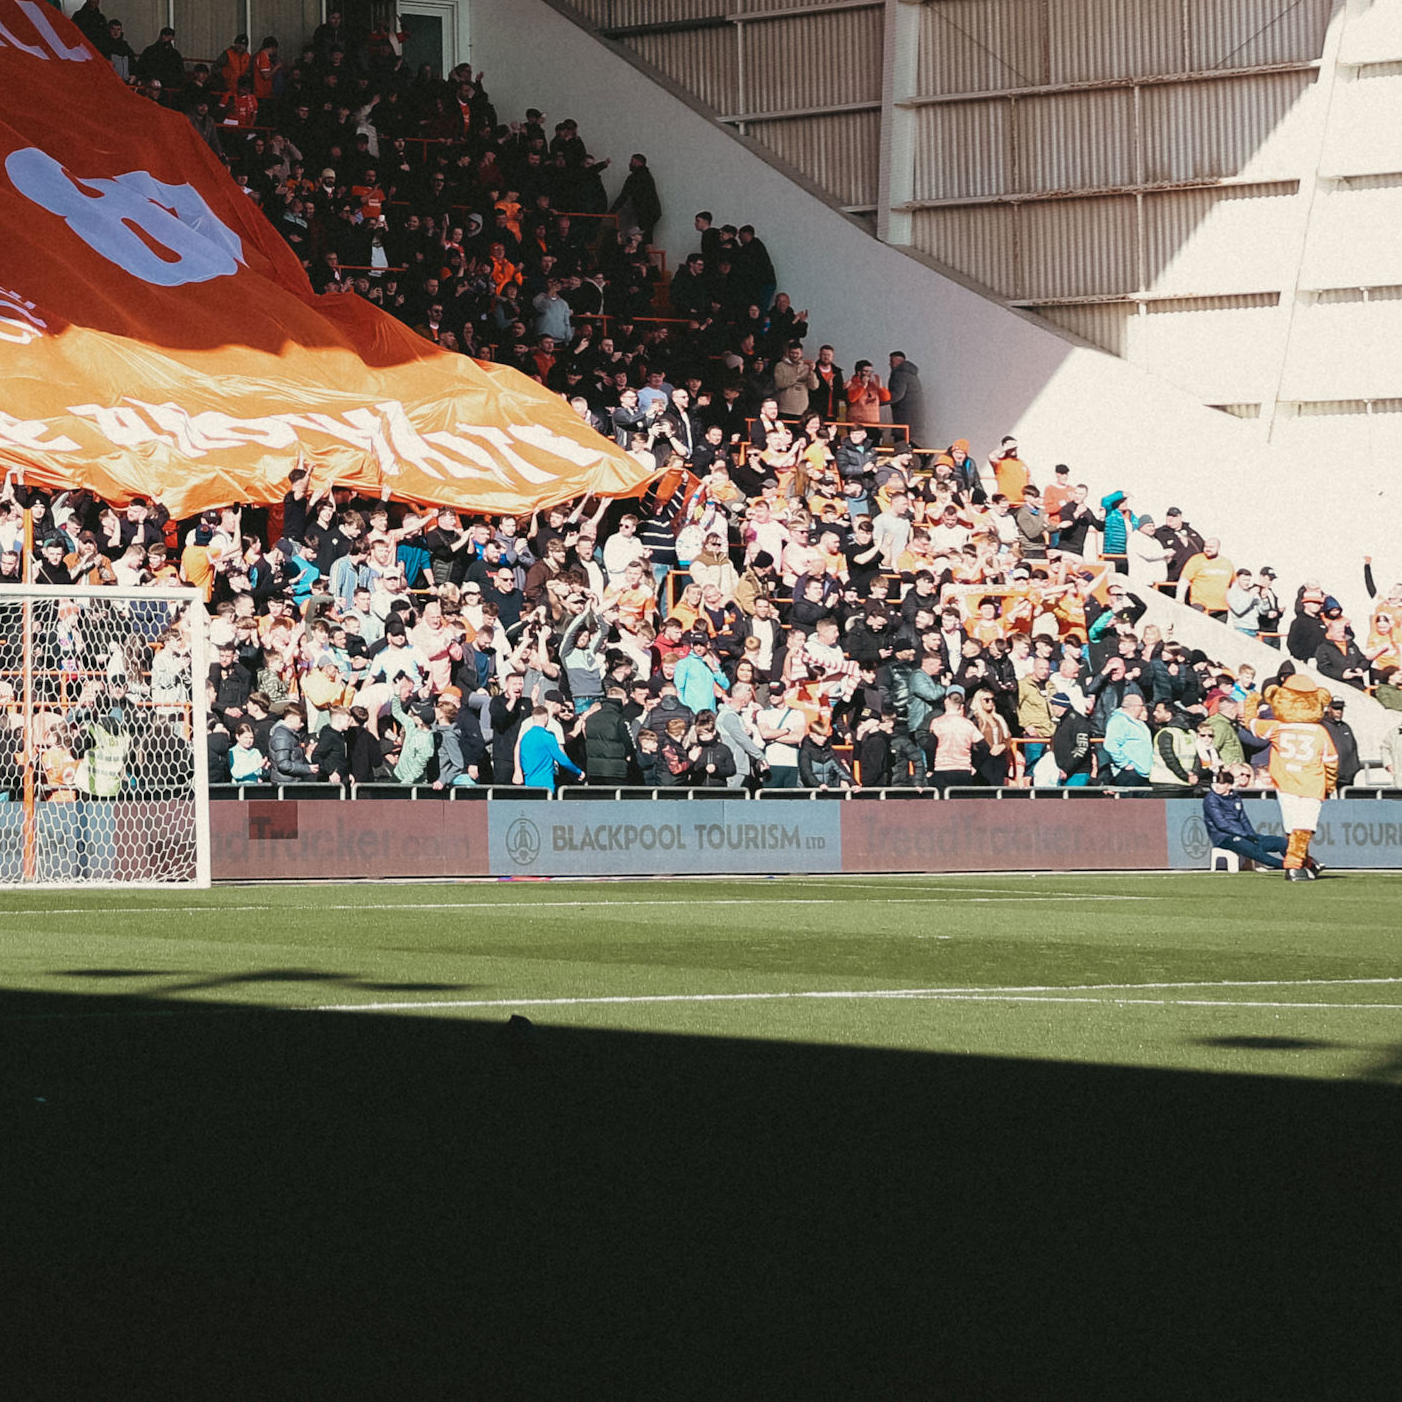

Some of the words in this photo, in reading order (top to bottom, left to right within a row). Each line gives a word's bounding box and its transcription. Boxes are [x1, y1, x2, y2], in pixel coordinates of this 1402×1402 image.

[1279, 733, 1315, 761] 53
[552, 824, 686, 851] BLACKPOOL
[694, 823, 801, 849] TOURISM
[805, 836, 826, 849] LTD
